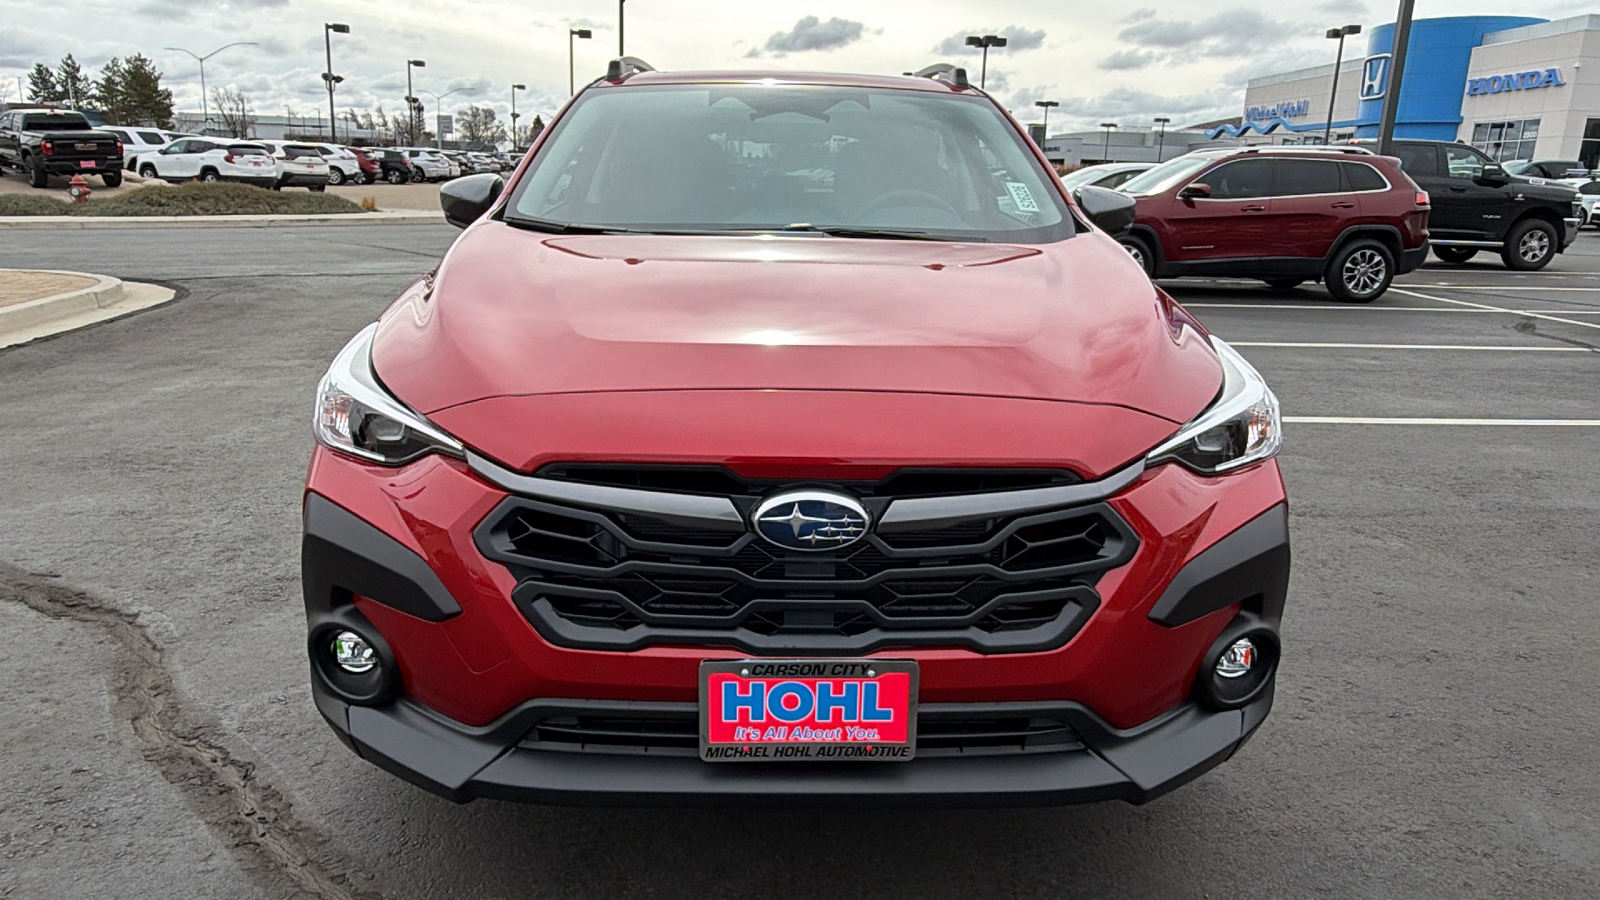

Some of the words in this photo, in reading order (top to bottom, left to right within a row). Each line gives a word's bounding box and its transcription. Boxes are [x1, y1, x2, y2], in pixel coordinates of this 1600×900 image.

[1466, 67, 1566, 96] HONDA
[1246, 103, 1280, 121] Michael
[1280, 99, 1309, 118] Hohl
[752, 664, 822, 676] CARSON
[831, 664, 871, 676] CITY
[722, 681, 894, 722] HOHL
[734, 726, 760, 740] It's
[763, 726, 787, 740] All
[790, 726, 842, 740] About
[845, 726, 880, 740] You.
[705, 746, 769, 758] MICHAEL
[773, 746, 812, 758] HOHL
[816, 746, 910, 758] AUTOMOTIVE
